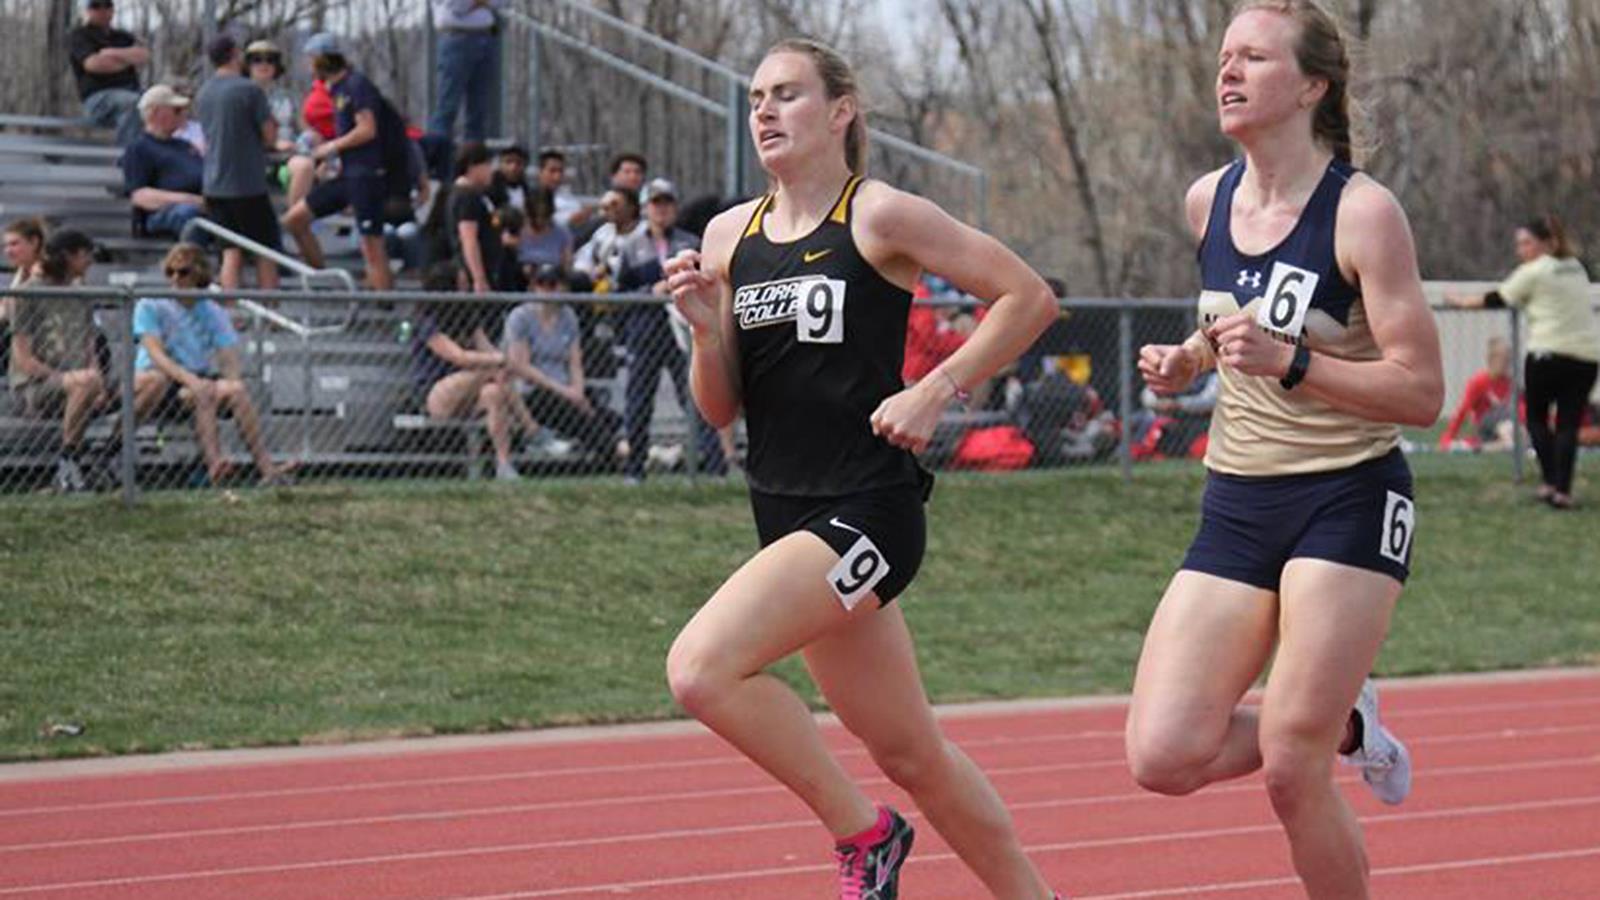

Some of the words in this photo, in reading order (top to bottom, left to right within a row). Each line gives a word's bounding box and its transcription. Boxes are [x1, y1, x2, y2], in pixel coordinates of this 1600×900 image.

[735, 282, 799, 308] COLORA
[744, 299, 799, 324] COLLE
[806, 282, 833, 339] 9
[1270, 271, 1305, 328] 6
[1390, 499, 1408, 557] 6
[835, 549, 880, 595] 9
